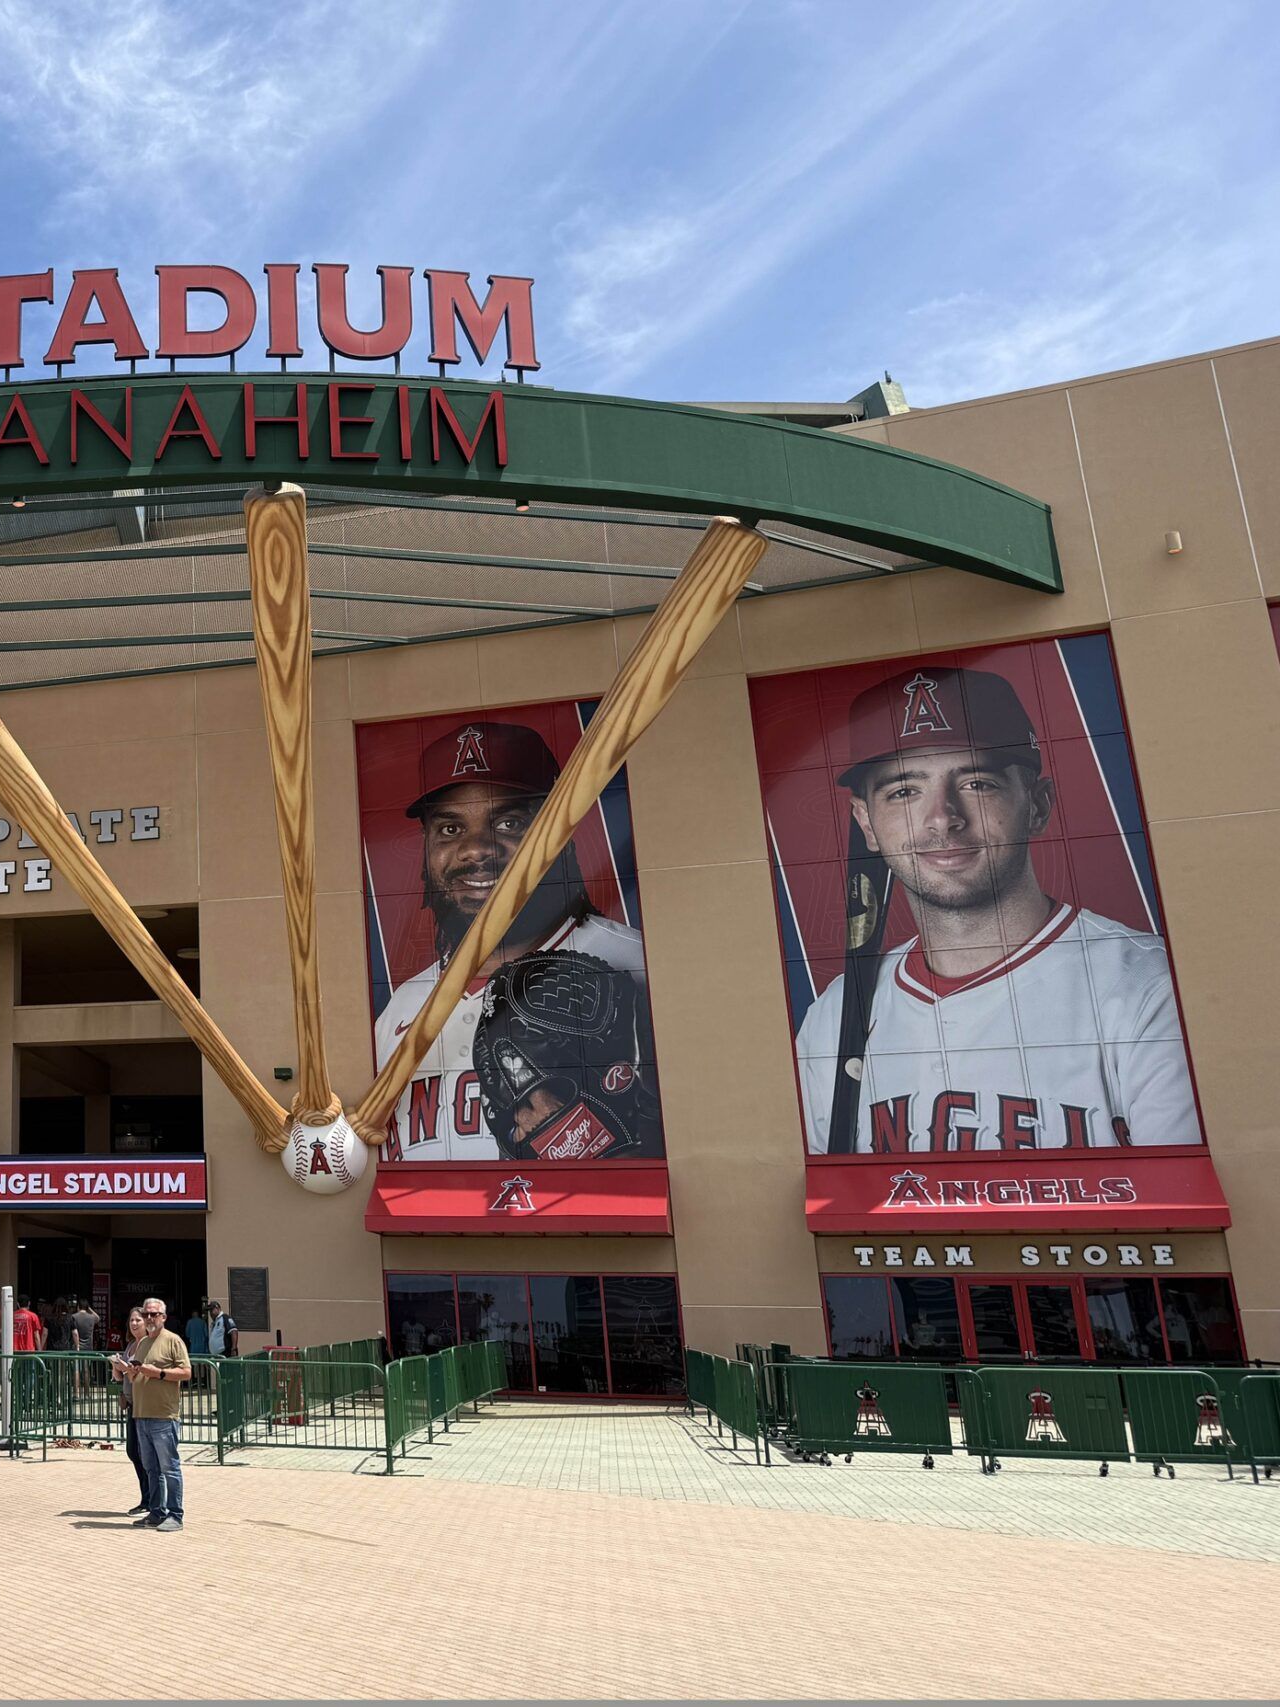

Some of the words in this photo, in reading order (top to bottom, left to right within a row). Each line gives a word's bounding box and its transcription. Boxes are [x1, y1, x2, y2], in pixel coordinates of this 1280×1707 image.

[900, 673, 952, 738] A
[452, 727, 491, 777] A
[309, 1137, 332, 1175] A
[548, 1118, 591, 1159] Rawlings
[64, 1172, 186, 1194] STADIUM
[488, 1175, 536, 1211] A
[883, 1169, 1137, 1208] ANGELS
[853, 1246, 974, 1267] TEAM
[1021, 1244, 1175, 1266] STORE
